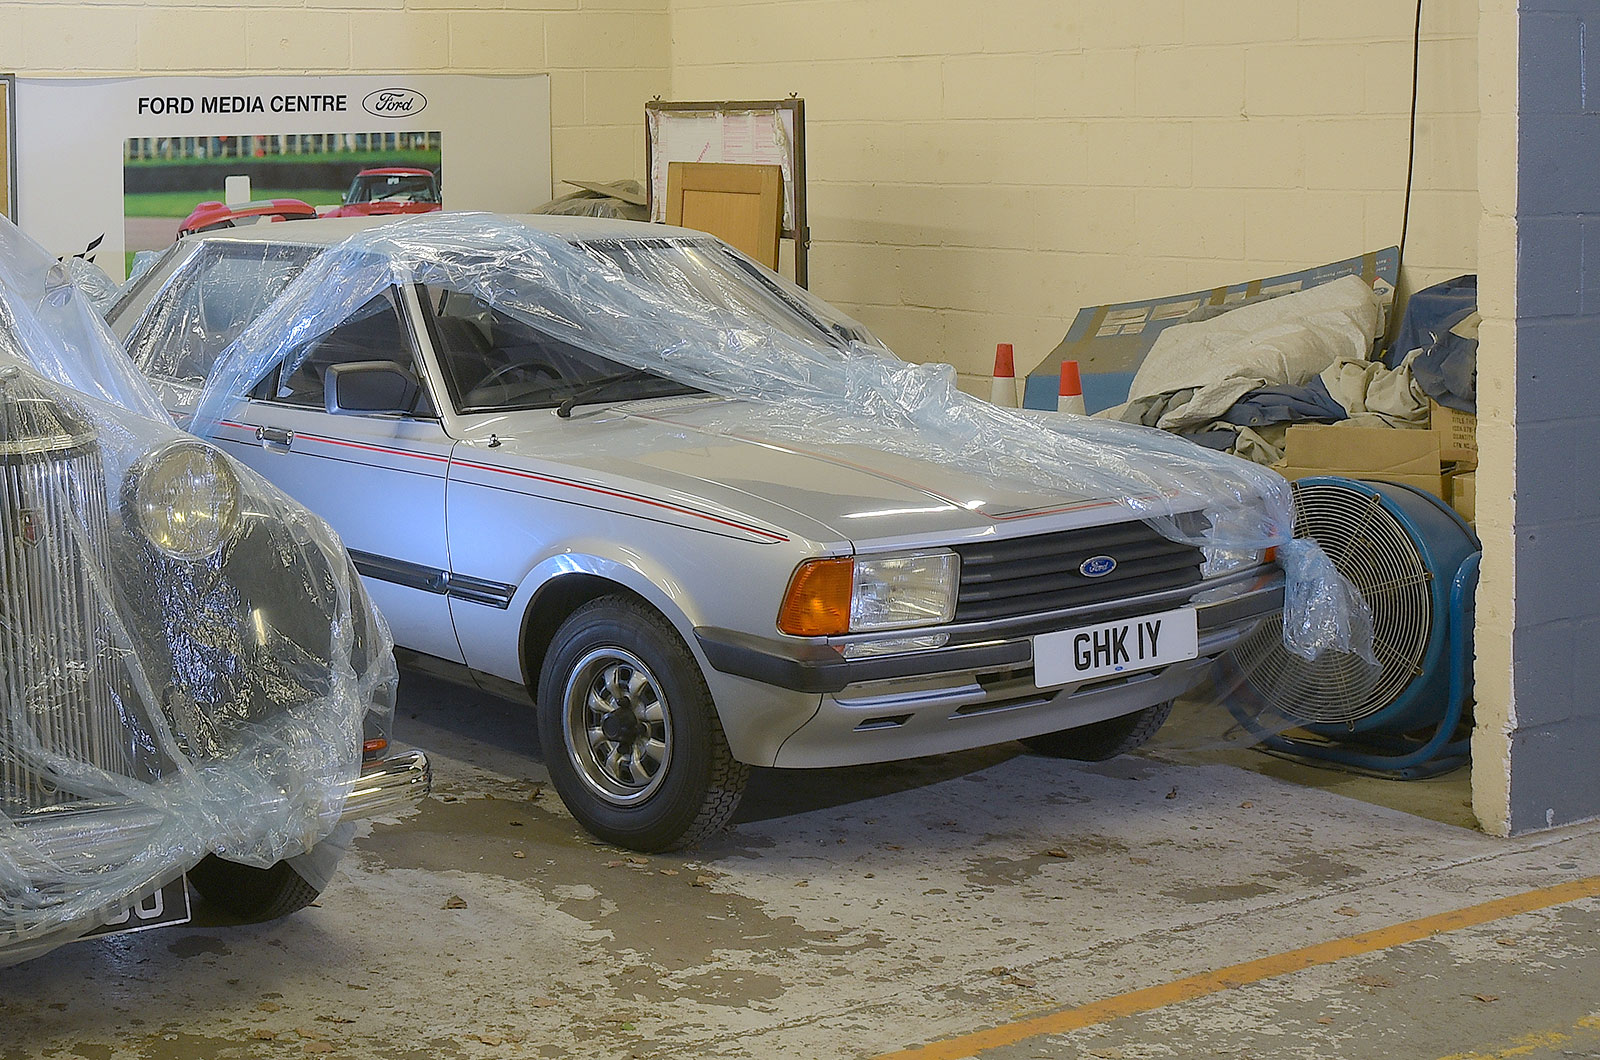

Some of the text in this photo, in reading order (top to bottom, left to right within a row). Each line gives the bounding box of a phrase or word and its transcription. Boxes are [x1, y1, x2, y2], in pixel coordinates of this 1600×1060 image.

[138, 95, 347, 114] FORD MEDIA CENTRE
[375, 92, 413, 112] Ford
[1073, 626, 1130, 671] GHK
